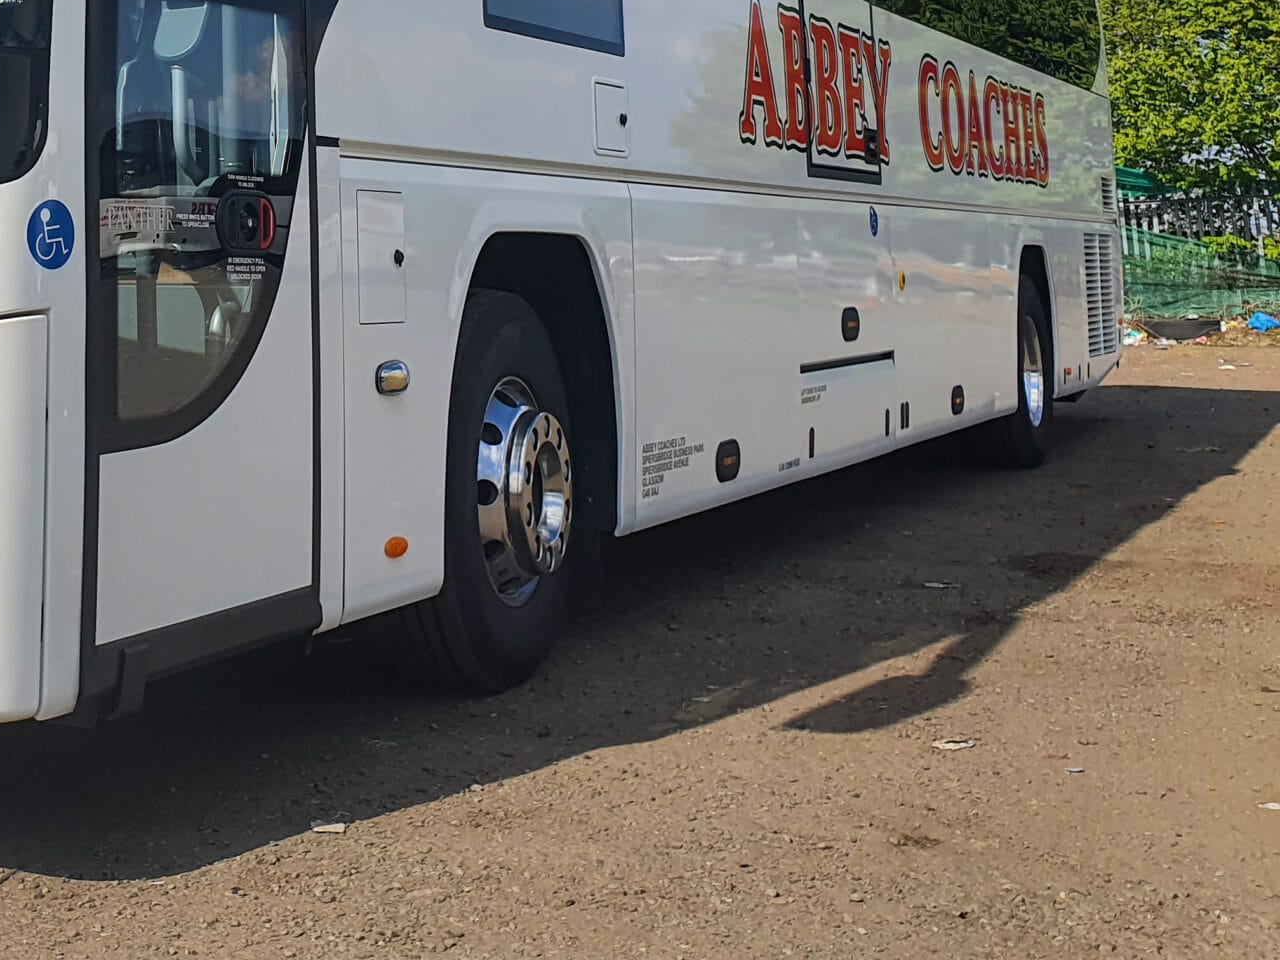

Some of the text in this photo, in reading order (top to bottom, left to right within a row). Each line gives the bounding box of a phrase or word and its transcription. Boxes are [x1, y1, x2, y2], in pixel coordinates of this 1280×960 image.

[919, 53, 1049, 188] COACHES
[105, 204, 176, 233] PANTHER
[643, 442, 657, 453] ABBEY
[658, 438, 677, 451] COACHES
